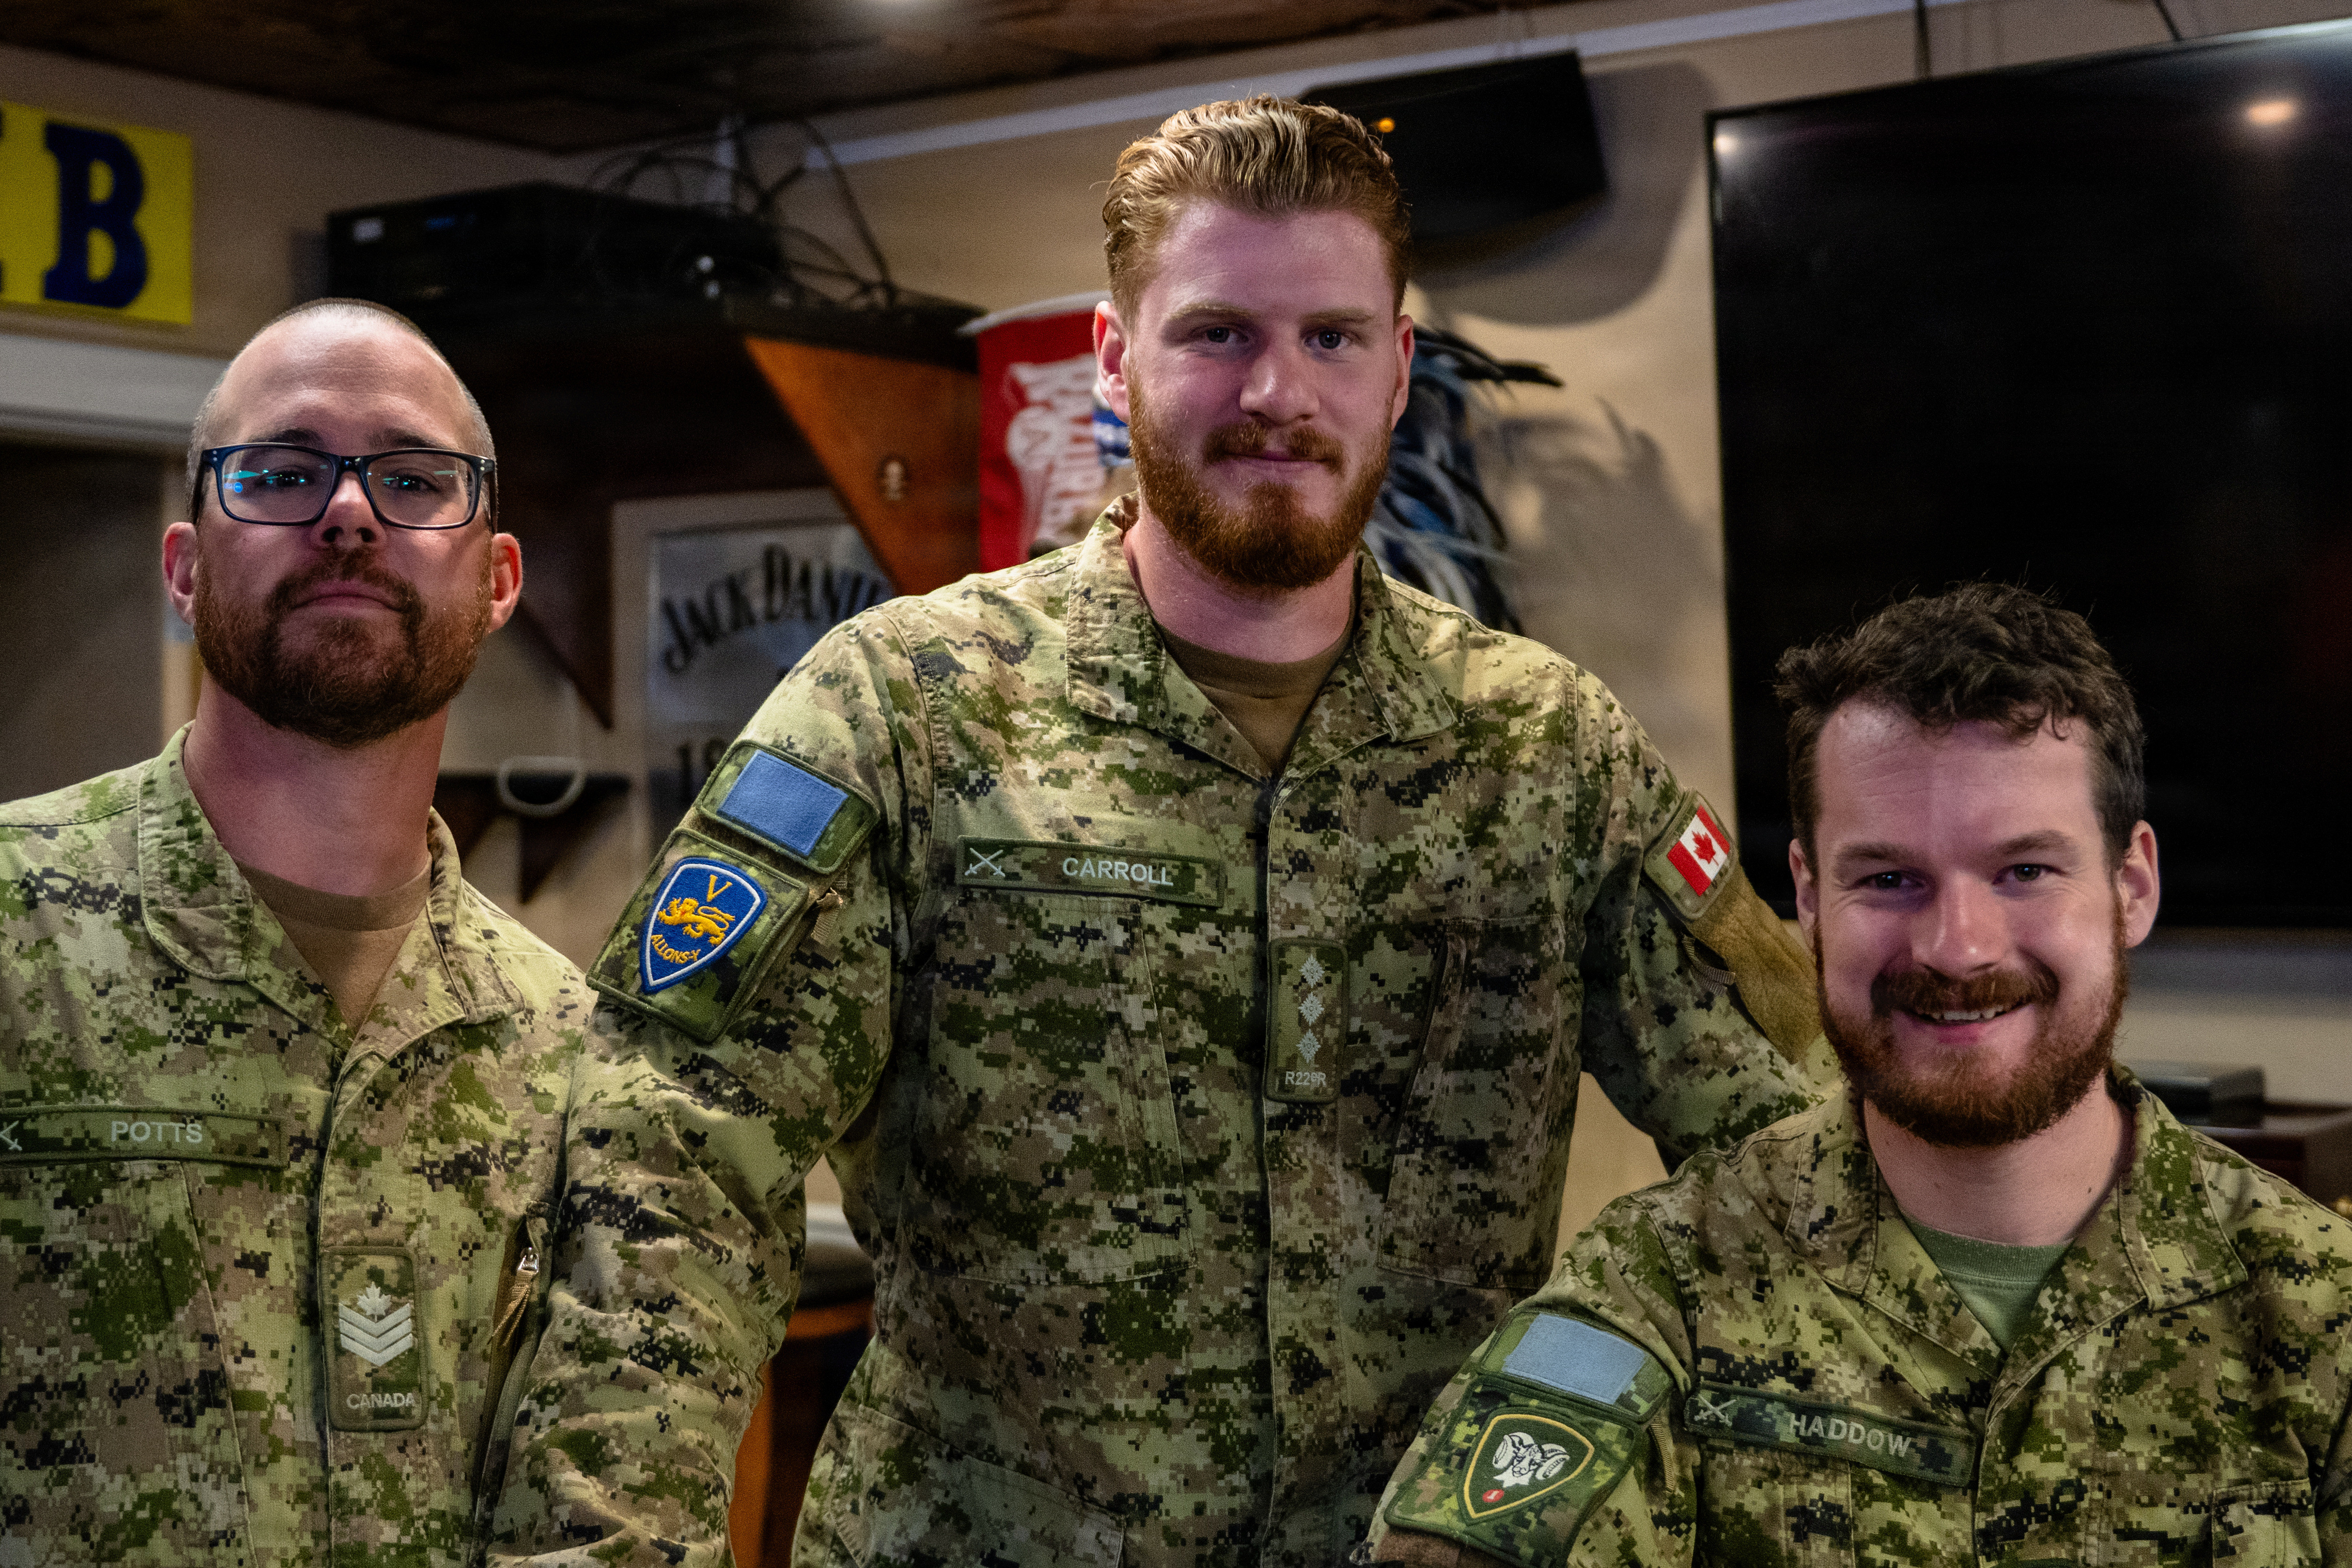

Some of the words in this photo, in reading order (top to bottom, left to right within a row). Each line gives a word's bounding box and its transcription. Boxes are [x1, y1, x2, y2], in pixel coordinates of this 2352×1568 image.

[0, 104, 148, 308] B
[1062, 857, 1174, 886] CARROLL
[707, 875, 732, 902] V
[651, 934, 701, 963] ALLONS-Y
[111, 1121, 203, 1143] POTTS
[346, 1393, 415, 1409] CANADA
[1789, 1414, 1912, 1458] HADDOW
